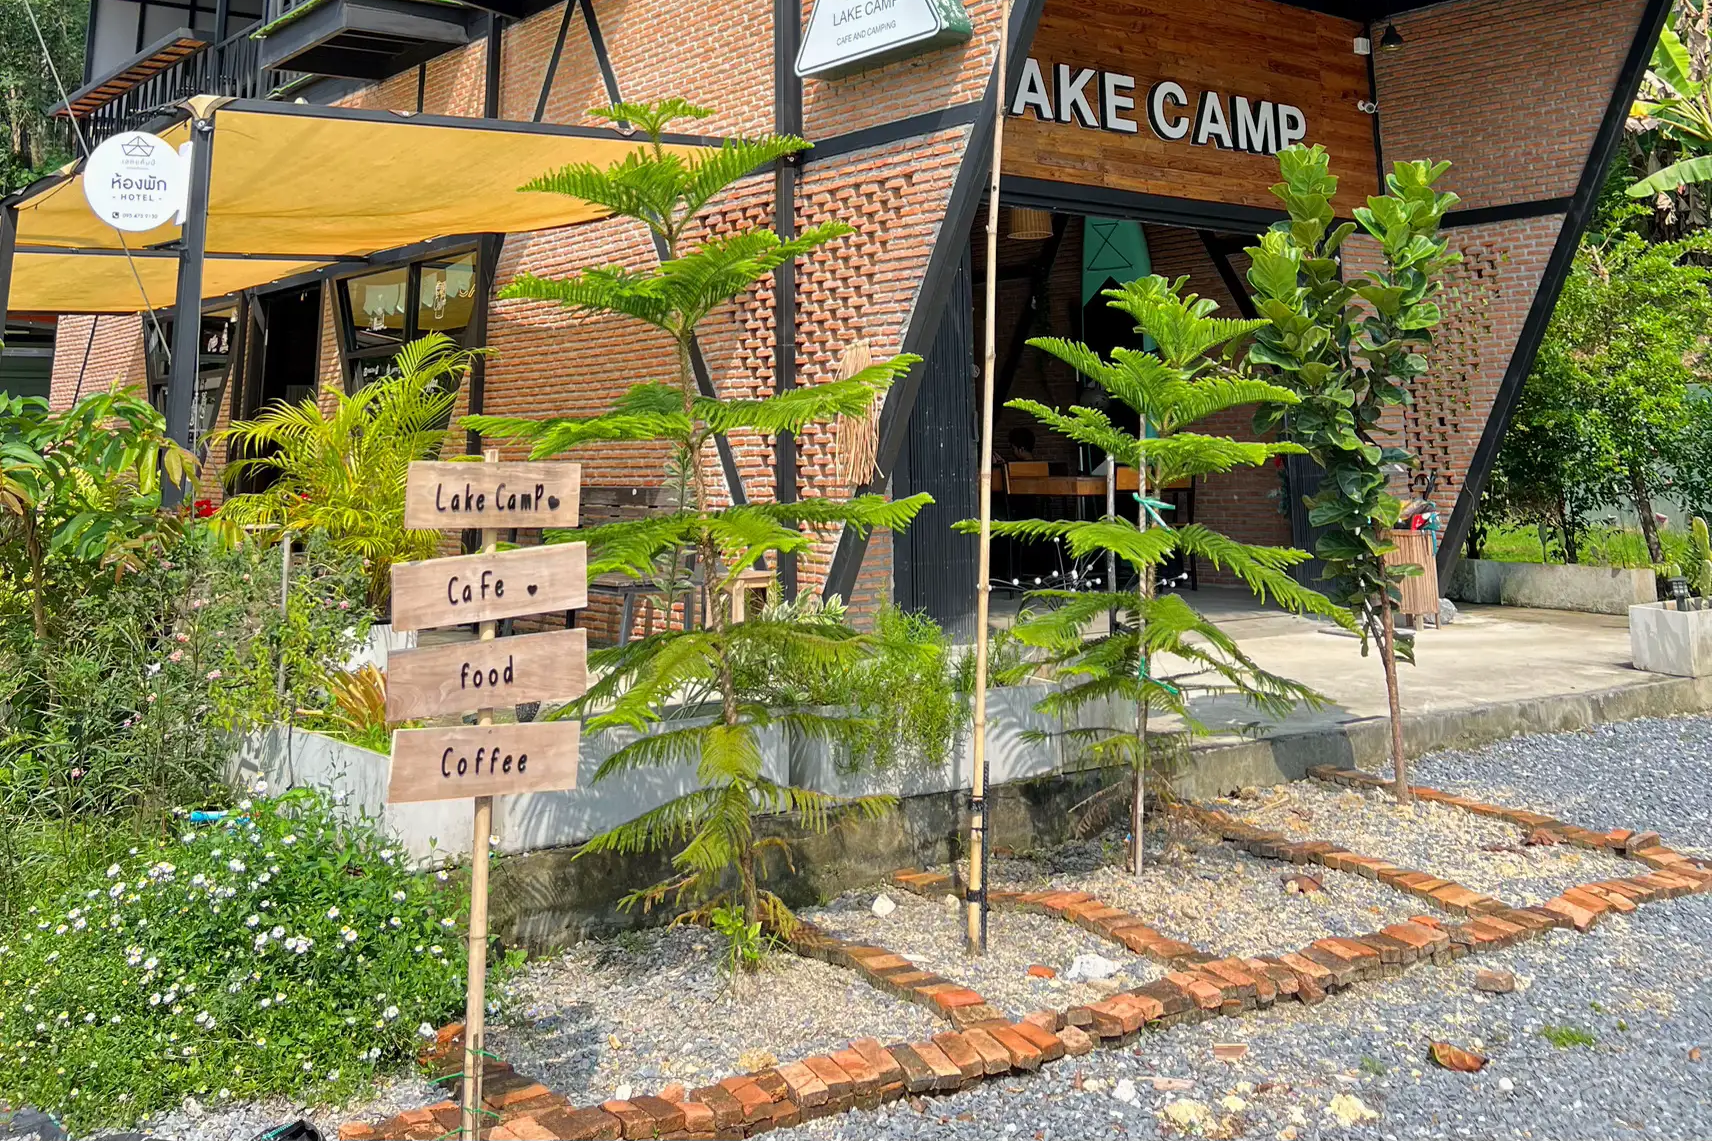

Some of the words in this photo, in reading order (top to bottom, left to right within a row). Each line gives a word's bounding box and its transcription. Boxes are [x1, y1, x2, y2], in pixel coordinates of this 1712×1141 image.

[833, 4, 862, 26] LAKE
[836, 34, 852, 46] CAFE
[853, 29, 866, 41] AND
[866, 19, 896, 36] CAMPING
[1009, 57, 1138, 134] AKE
[1146, 81, 1307, 155] CAMP
[111, 172, 167, 191] ห้องพัก
[120, 193, 154, 201] HOTEL
[436, 483, 485, 513] Lake
[441, 746, 528, 778] Coffee
